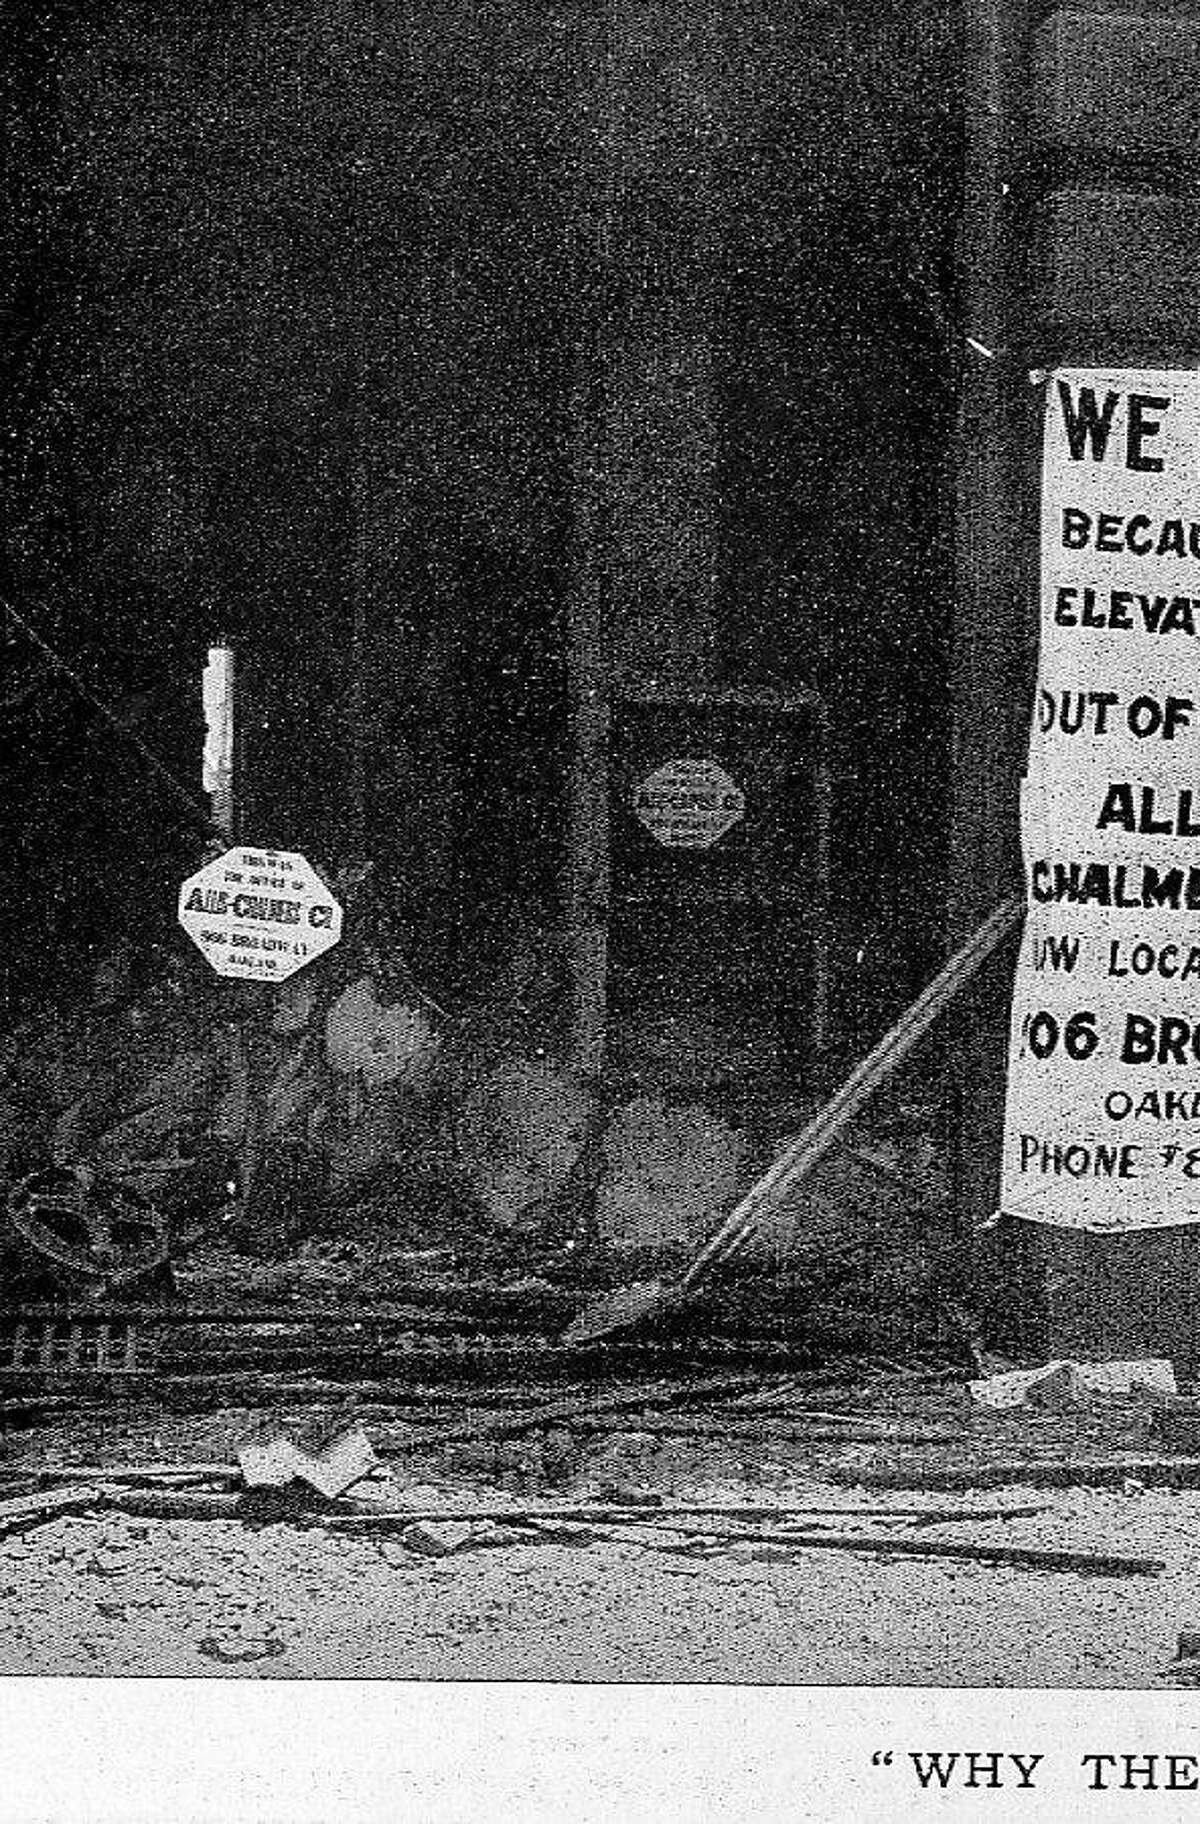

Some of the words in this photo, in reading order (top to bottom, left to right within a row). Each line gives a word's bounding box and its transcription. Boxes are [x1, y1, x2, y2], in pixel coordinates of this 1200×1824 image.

[1057, 381, 1170, 473] WE
[1127, 695, 1194, 740] OF
[1020, 1010, 1101, 1061] 06
[1019, 1134, 1142, 1179] PHONE
